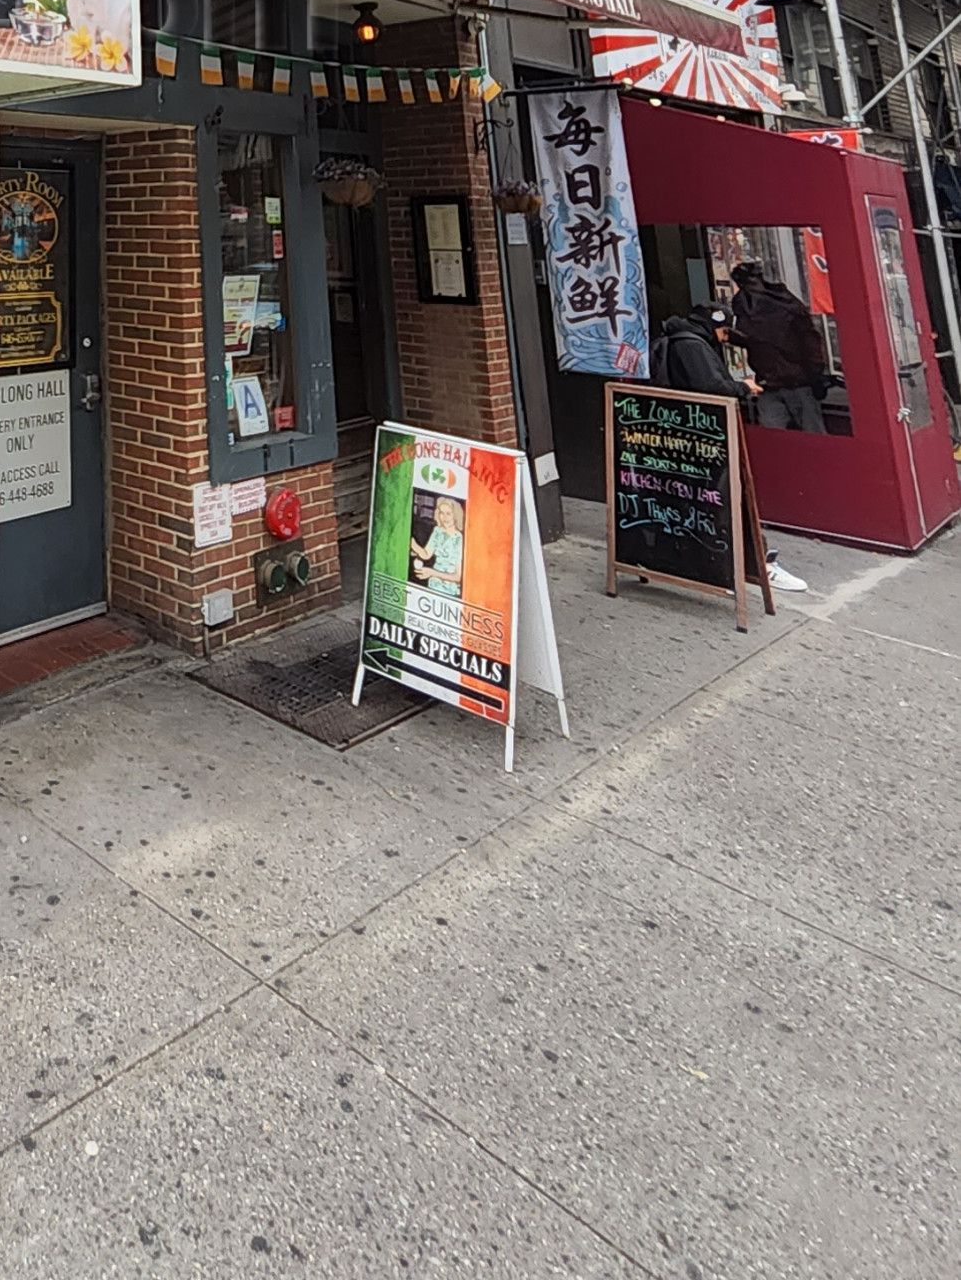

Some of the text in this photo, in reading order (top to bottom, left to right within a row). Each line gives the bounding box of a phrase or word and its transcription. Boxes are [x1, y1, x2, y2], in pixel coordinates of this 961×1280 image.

[1, 379, 66, 404] LONG HALL
[242, 384, 262, 419] A
[18, 411, 65, 430] ENTRANCE
[615, 397, 642, 419] THE
[6, 434, 35, 453] ONLY
[625, 431, 663, 448] WINTER
[0, 461, 60, 485] ACCESS CALL
[620, 469, 663, 492] KITCHEN
[697, 487, 724, 507] LATE
[618, 492, 639, 518] DJ
[373, 579, 412, 603] BEST
[418, 597, 504, 640] GUINNESS
[369, 616, 503, 683] DAILY SPECIALS
